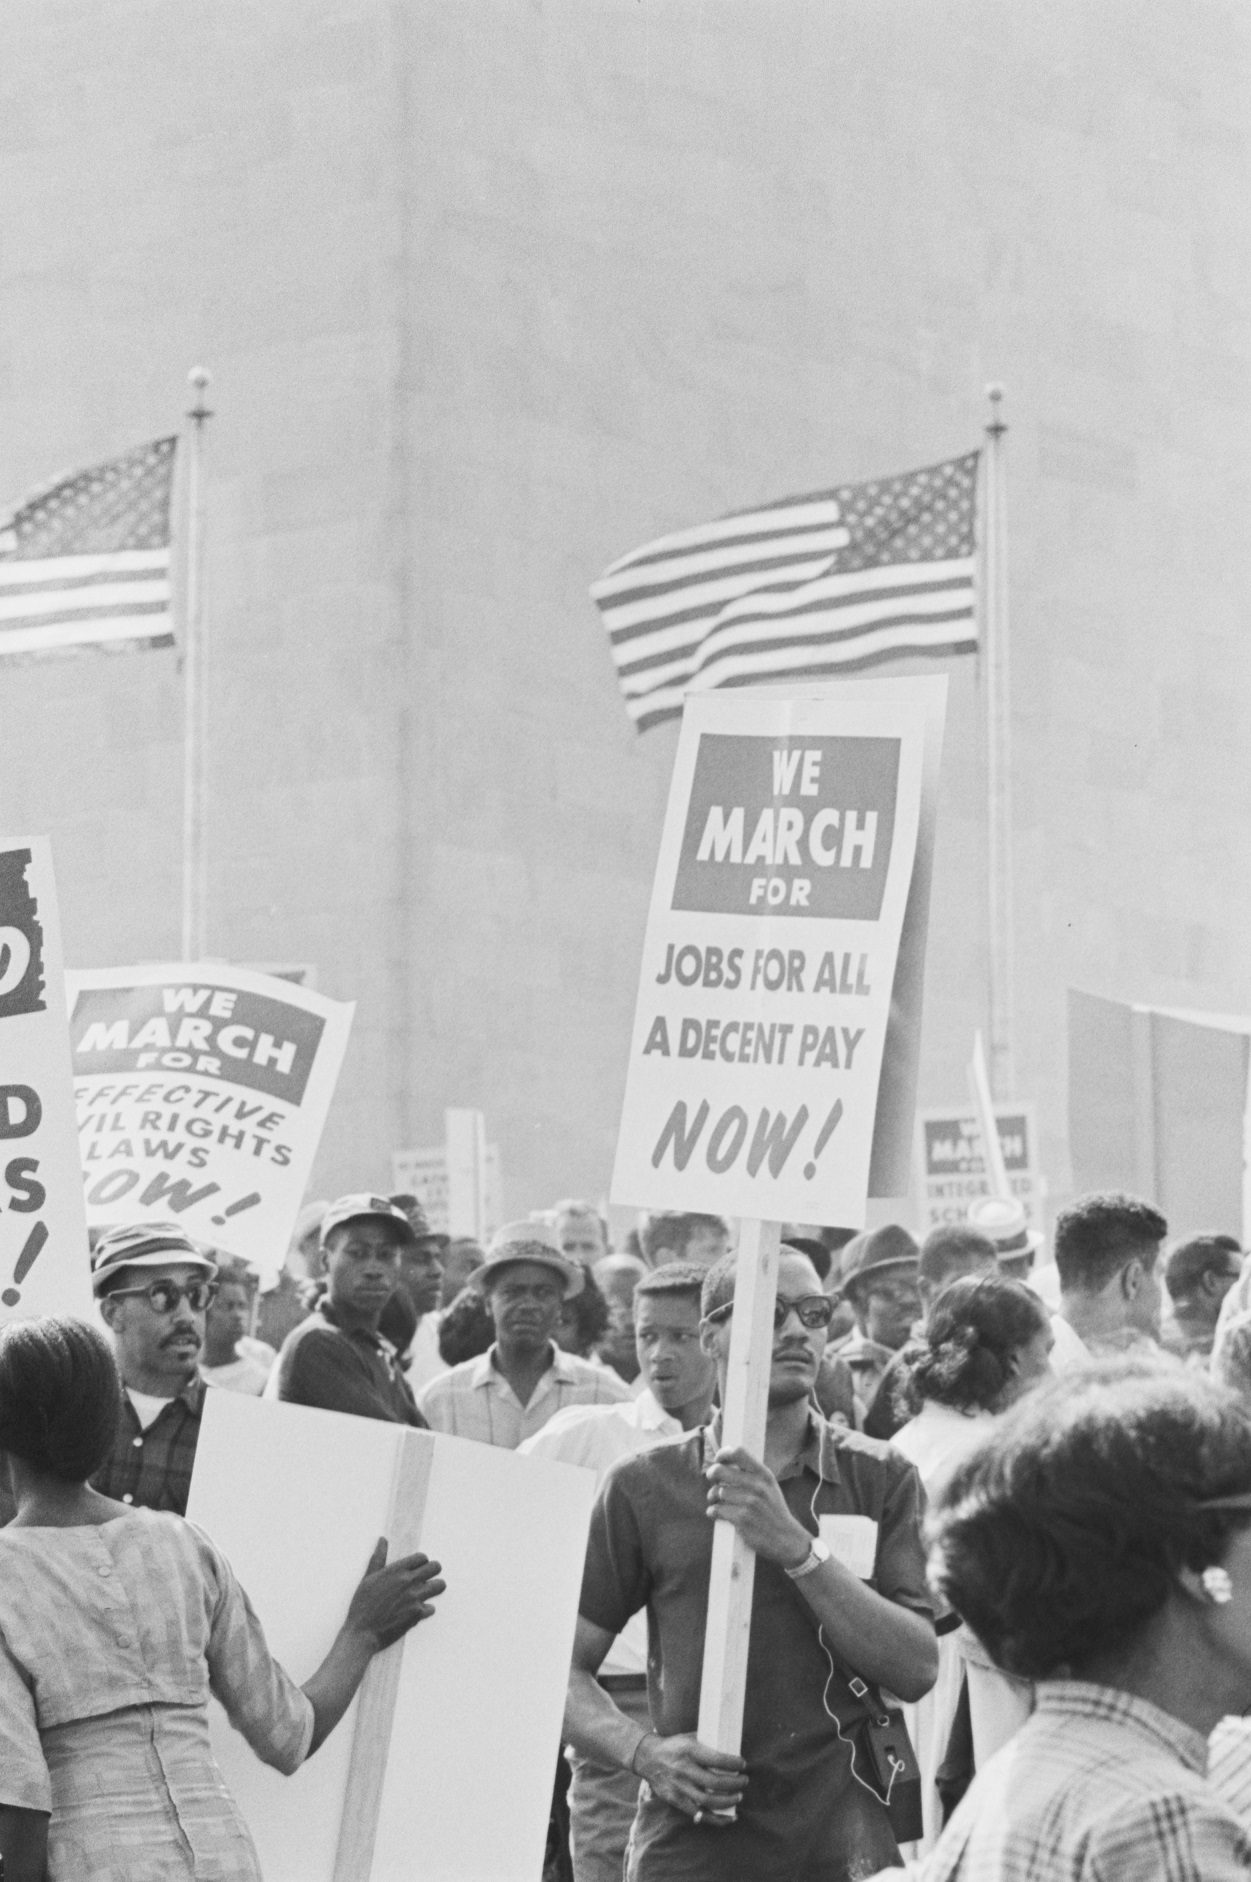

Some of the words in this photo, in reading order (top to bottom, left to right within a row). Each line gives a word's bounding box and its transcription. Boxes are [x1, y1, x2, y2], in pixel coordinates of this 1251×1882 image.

[772, 749, 823, 796] WE
[696, 804, 879, 868] MARCH
[749, 877, 812, 907] FOR
[655, 943, 744, 991] JOBS
[750, 948, 806, 993] FOR
[813, 951, 871, 997] ALL
[162, 987, 238, 1019] WE
[76, 1016, 298, 1075] MARCH
[136, 1051, 222, 1076] FOR
[642, 1015, 671, 1057] A
[678, 1017, 793, 1064] DECENT
[797, 1024, 866, 1070] PAY
[86, 1136, 211, 1169] LAWS
[139, 1109, 293, 1167] RIGHTS
[650, 1098, 843, 1181] NOW!
[931, 1135, 1023, 1162] MAH
[83, 1168, 262, 1226] OW!
